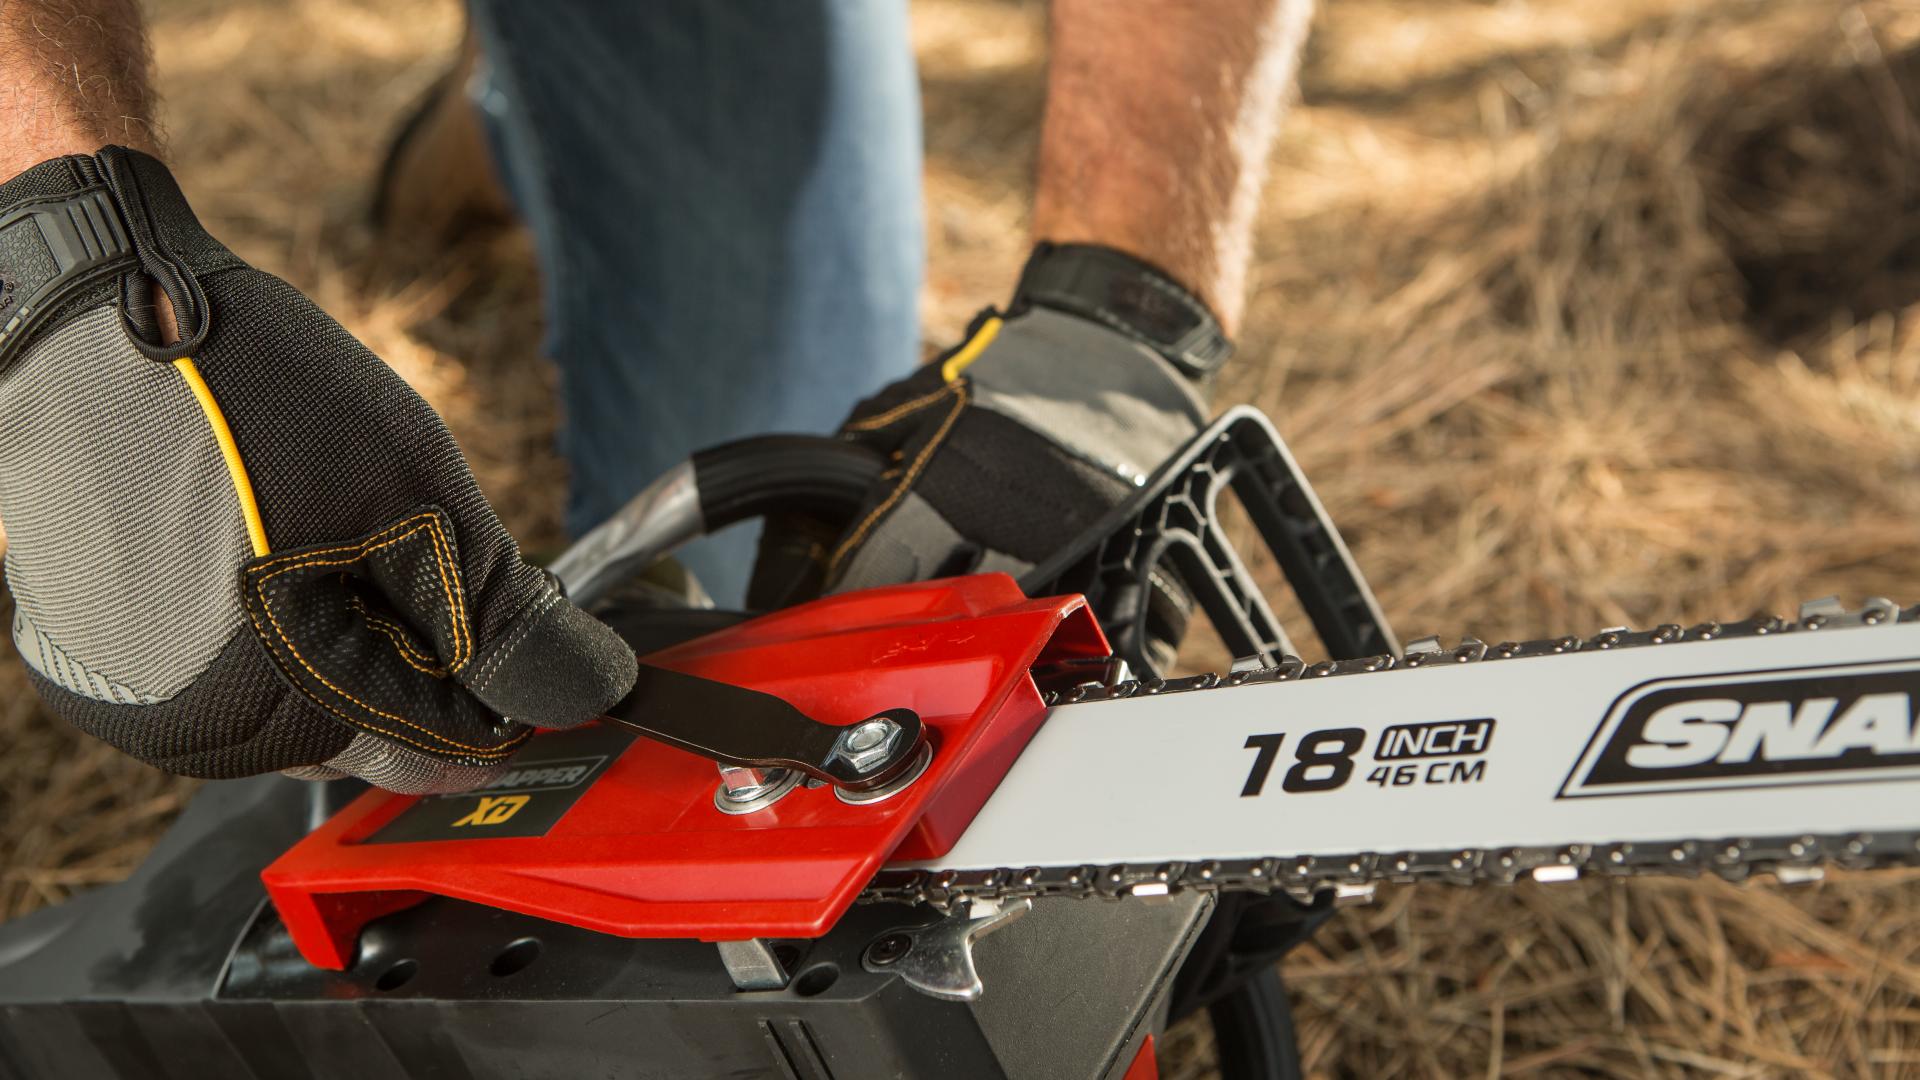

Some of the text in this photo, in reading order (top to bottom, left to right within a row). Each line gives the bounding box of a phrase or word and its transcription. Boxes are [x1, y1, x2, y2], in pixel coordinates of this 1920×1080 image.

[1625, 691, 1920, 769] SNA
[1240, 722, 1489, 798] 18 INCH
[1366, 760, 1488, 788] 46 CM
[488, 766, 588, 788] APPER
[449, 795, 532, 827] XD
